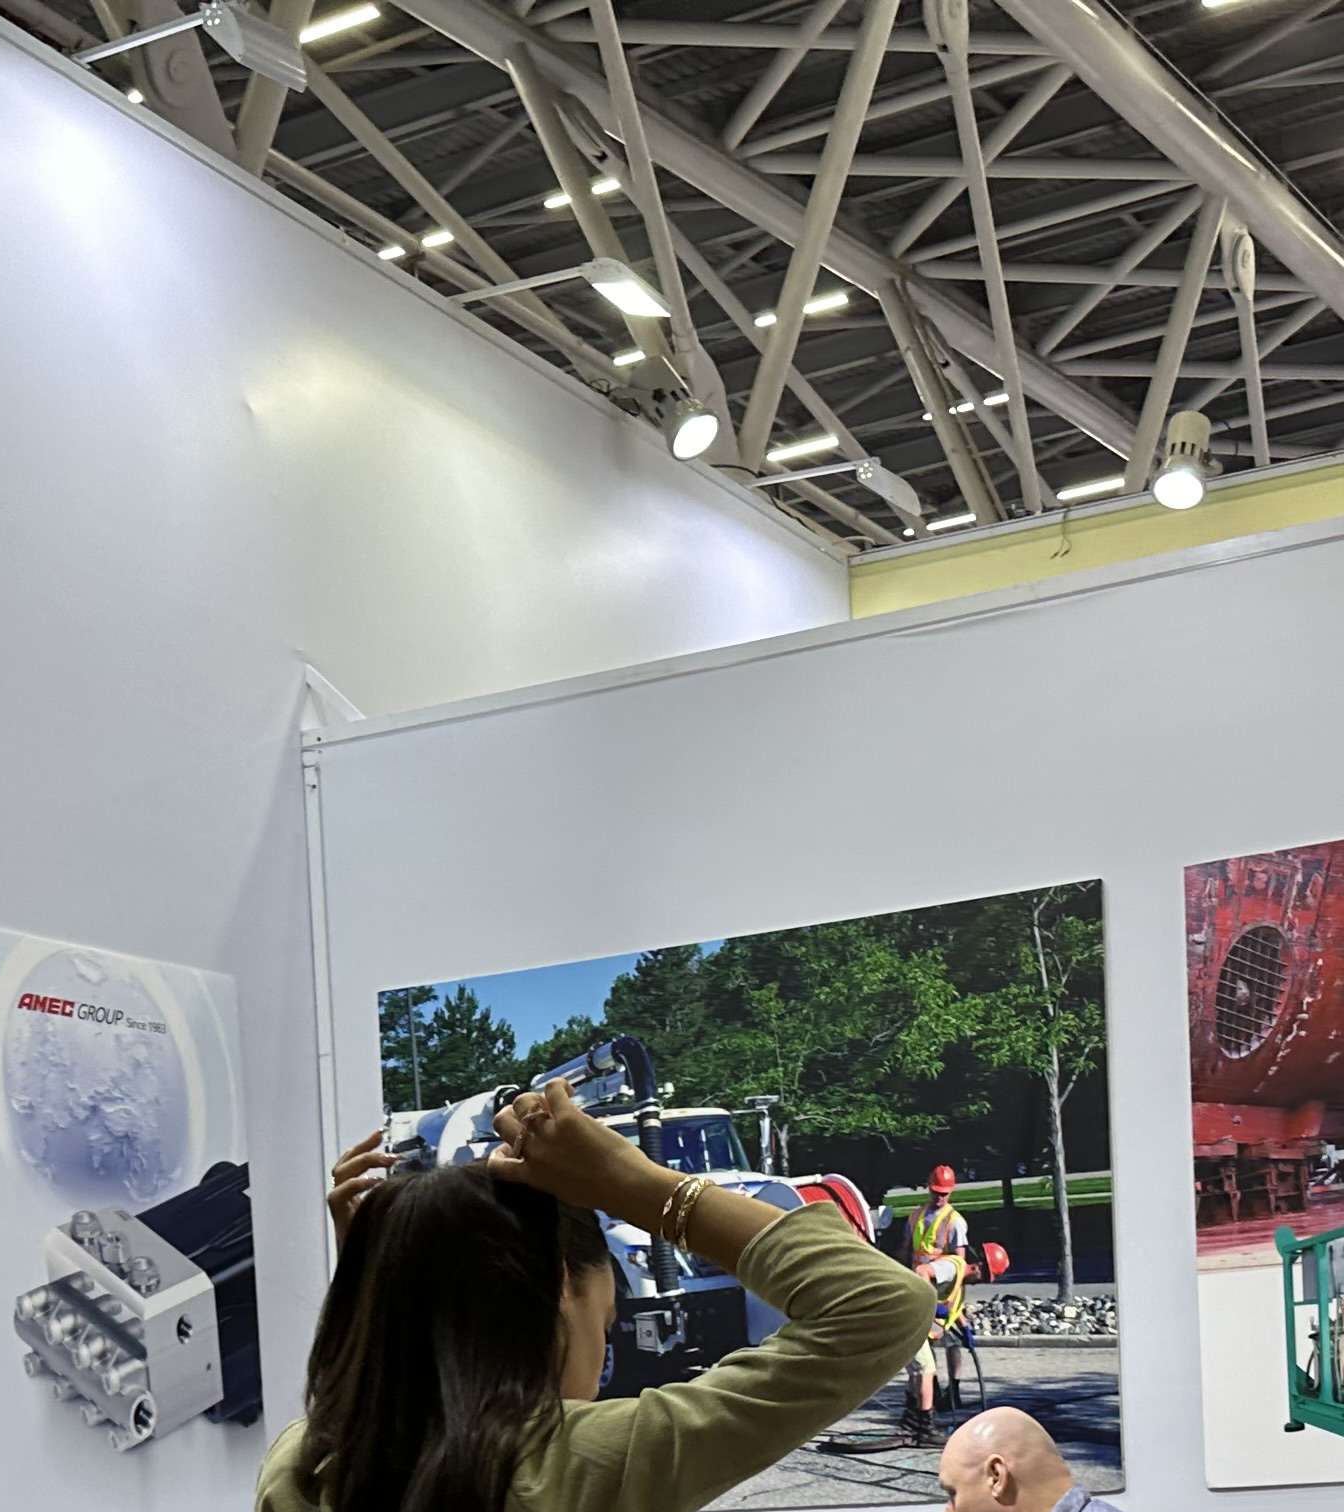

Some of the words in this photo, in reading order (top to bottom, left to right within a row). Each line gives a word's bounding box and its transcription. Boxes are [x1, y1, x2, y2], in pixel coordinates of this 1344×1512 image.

[17, 993, 76, 1018] AMEC
[77, 1003, 124, 1025] GROUP
[126, 1017, 147, 1031] Since
